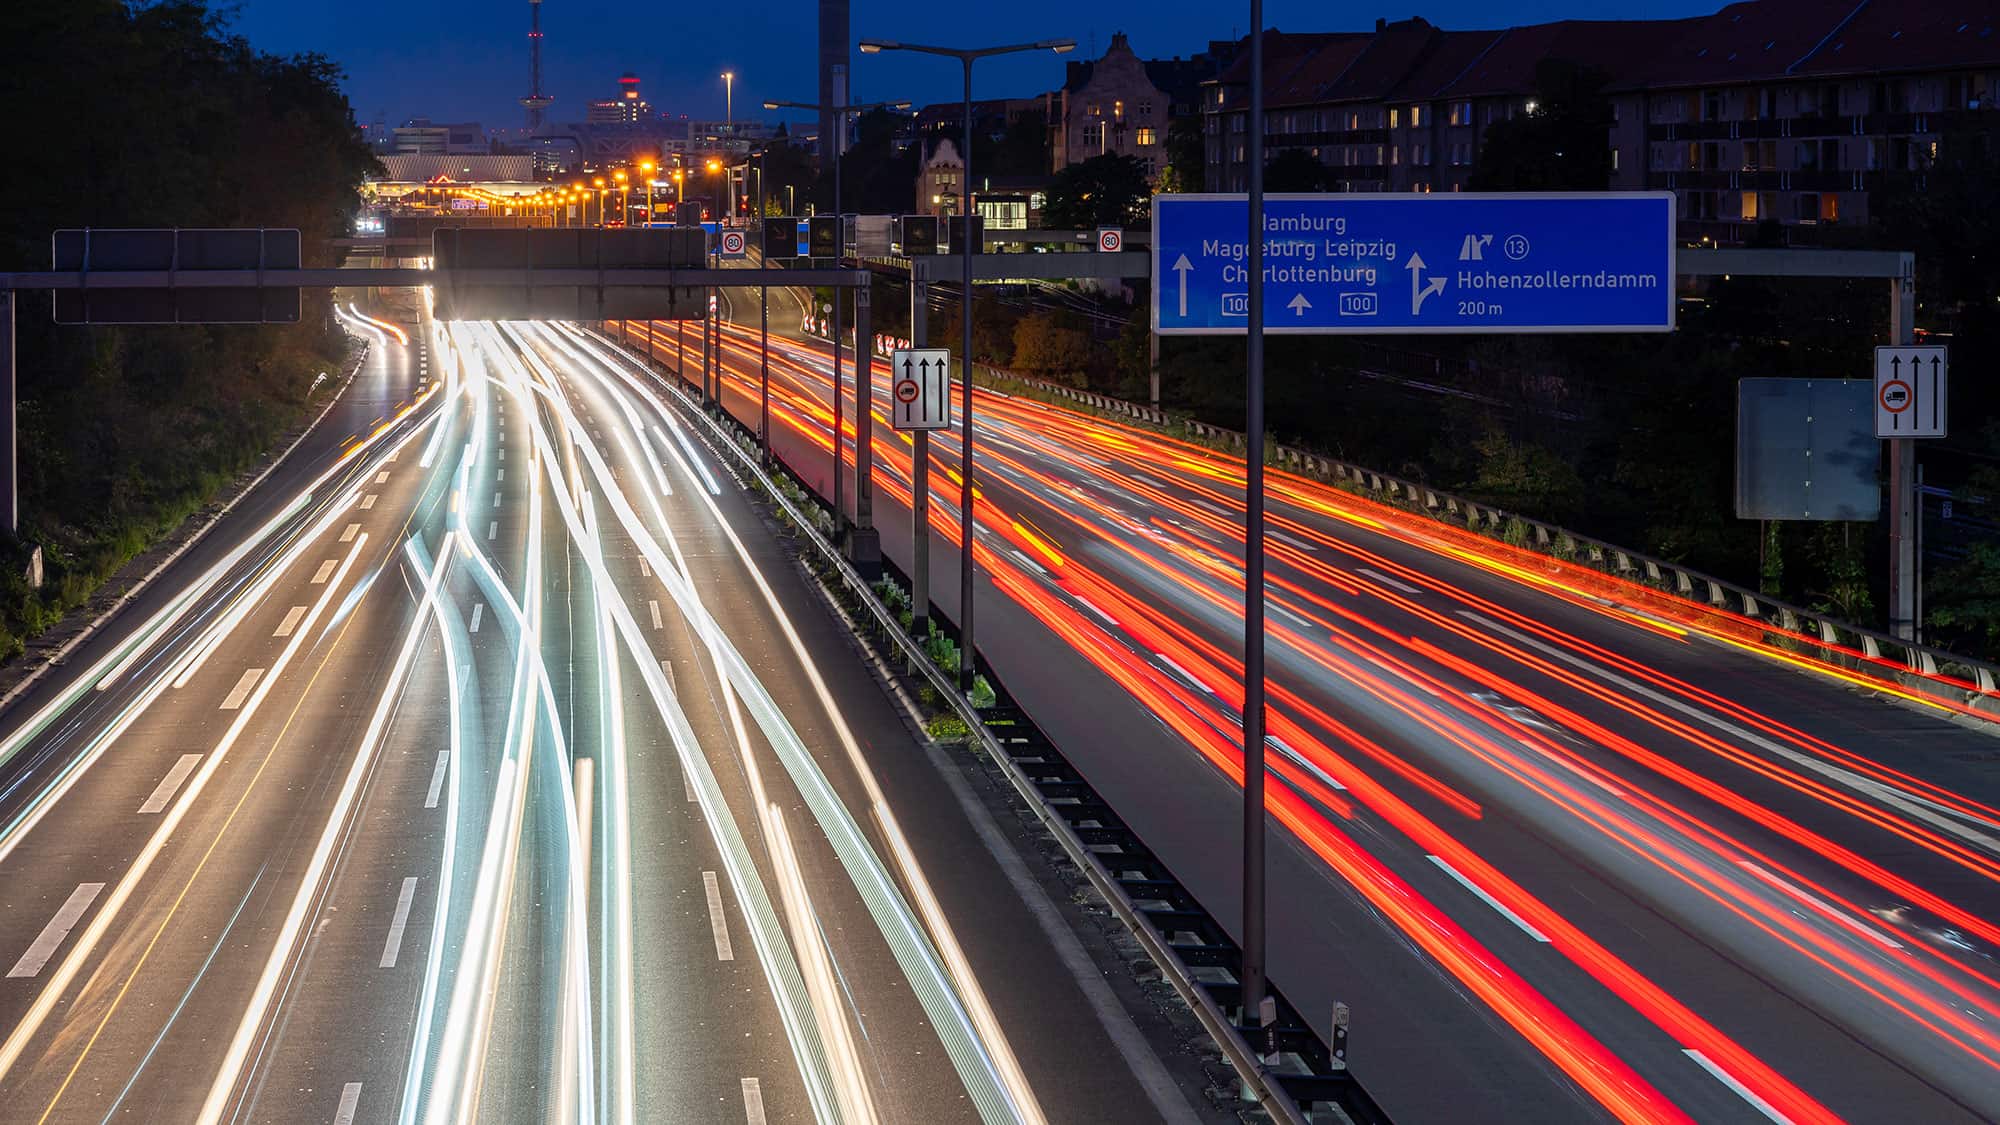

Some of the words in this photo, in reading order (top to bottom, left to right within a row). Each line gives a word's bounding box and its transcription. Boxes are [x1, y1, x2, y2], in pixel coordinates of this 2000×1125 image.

[1262, 212, 1346, 236] amburg
[728, 238, 739, 248] 80
[1105, 236, 1116, 246] 80
[1509, 240, 1524, 254] 13
[1325, 238, 1396, 262] Leipzig
[1223, 264, 1376, 287] Chrlottenburg
[1458, 270, 1657, 289] Hohenzollerndamm
[1346, 297, 1371, 311] 100
[1458, 301, 1486, 315] 200
[1488, 304, 1503, 315] m
